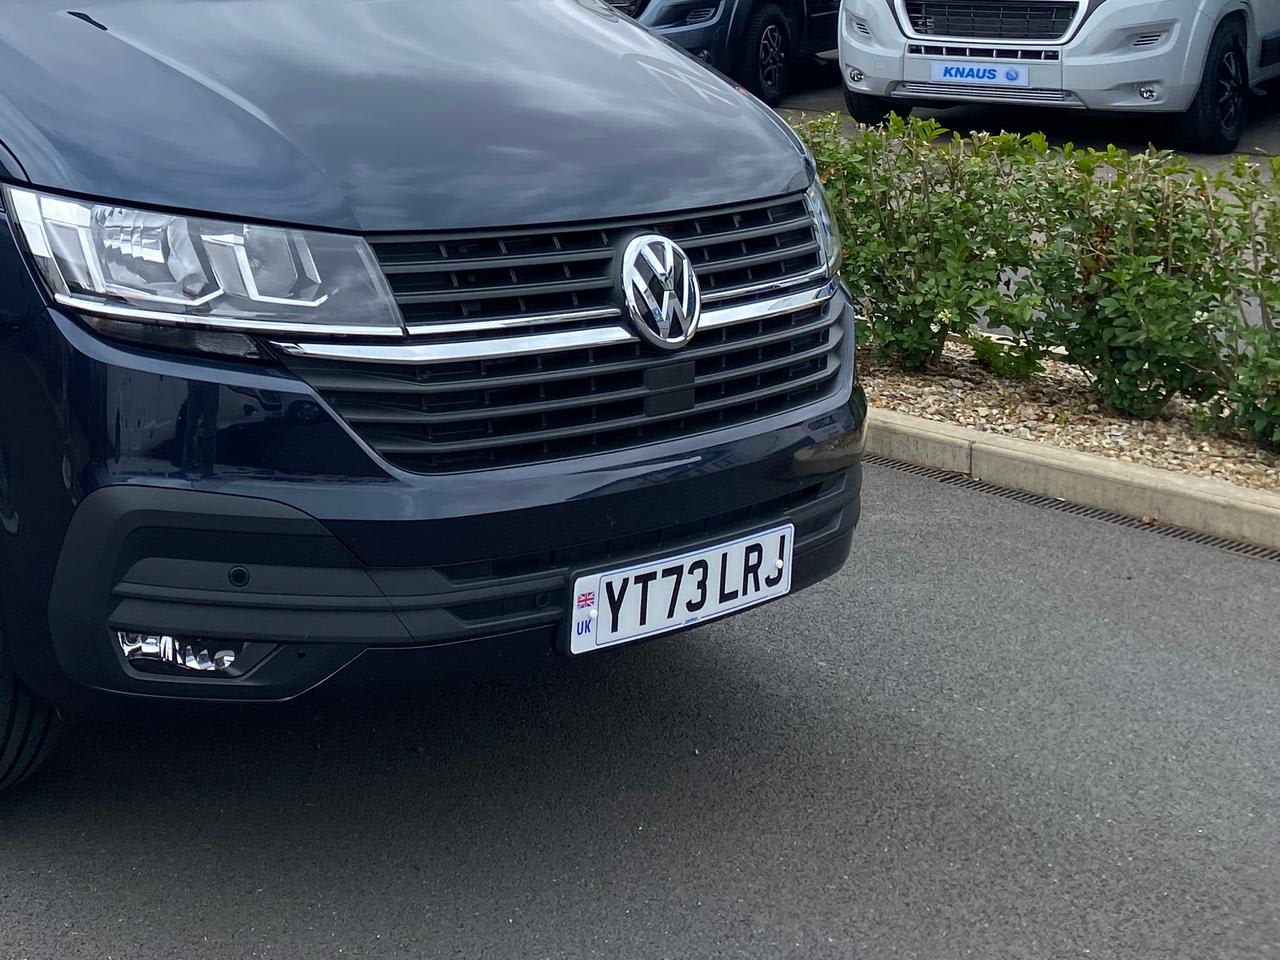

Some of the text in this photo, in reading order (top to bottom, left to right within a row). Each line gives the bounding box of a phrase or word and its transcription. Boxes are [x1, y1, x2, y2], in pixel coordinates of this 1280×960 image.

[943, 66, 998, 80] KNAUS
[605, 534, 786, 634] YT73 LRJ
[576, 619, 592, 636] UK
